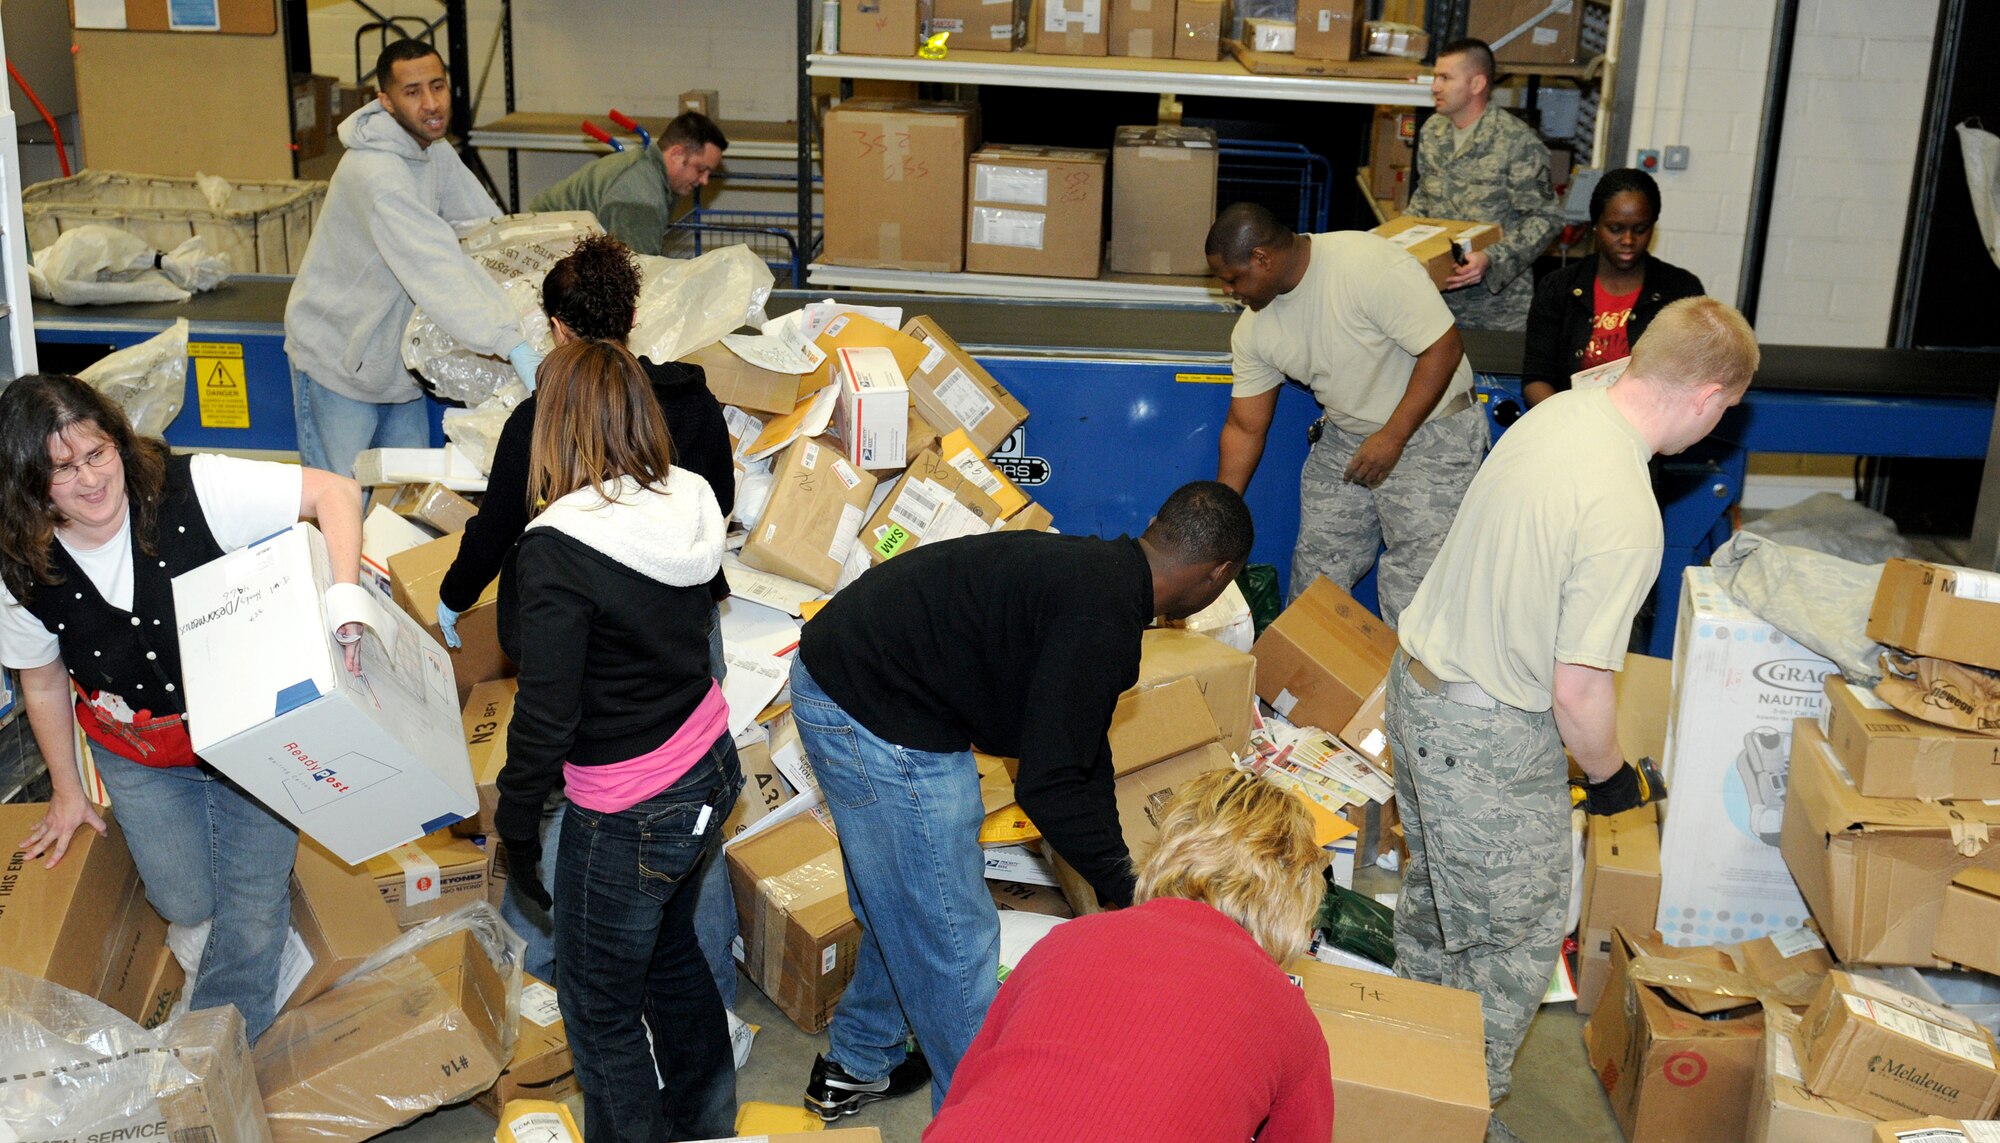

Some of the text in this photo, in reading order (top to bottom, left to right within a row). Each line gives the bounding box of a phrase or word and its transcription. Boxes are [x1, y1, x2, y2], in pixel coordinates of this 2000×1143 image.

[880, 528, 904, 553] SAM
[1758, 693, 1822, 708] NAUTIL
[1931, 687, 1974, 715] newegg
[469, 722, 497, 744] N3
[283, 742, 349, 793] ReadyPost
[441, 1055, 470, 1077] #14
[1882, 1059, 1960, 1098] Melaleuca
